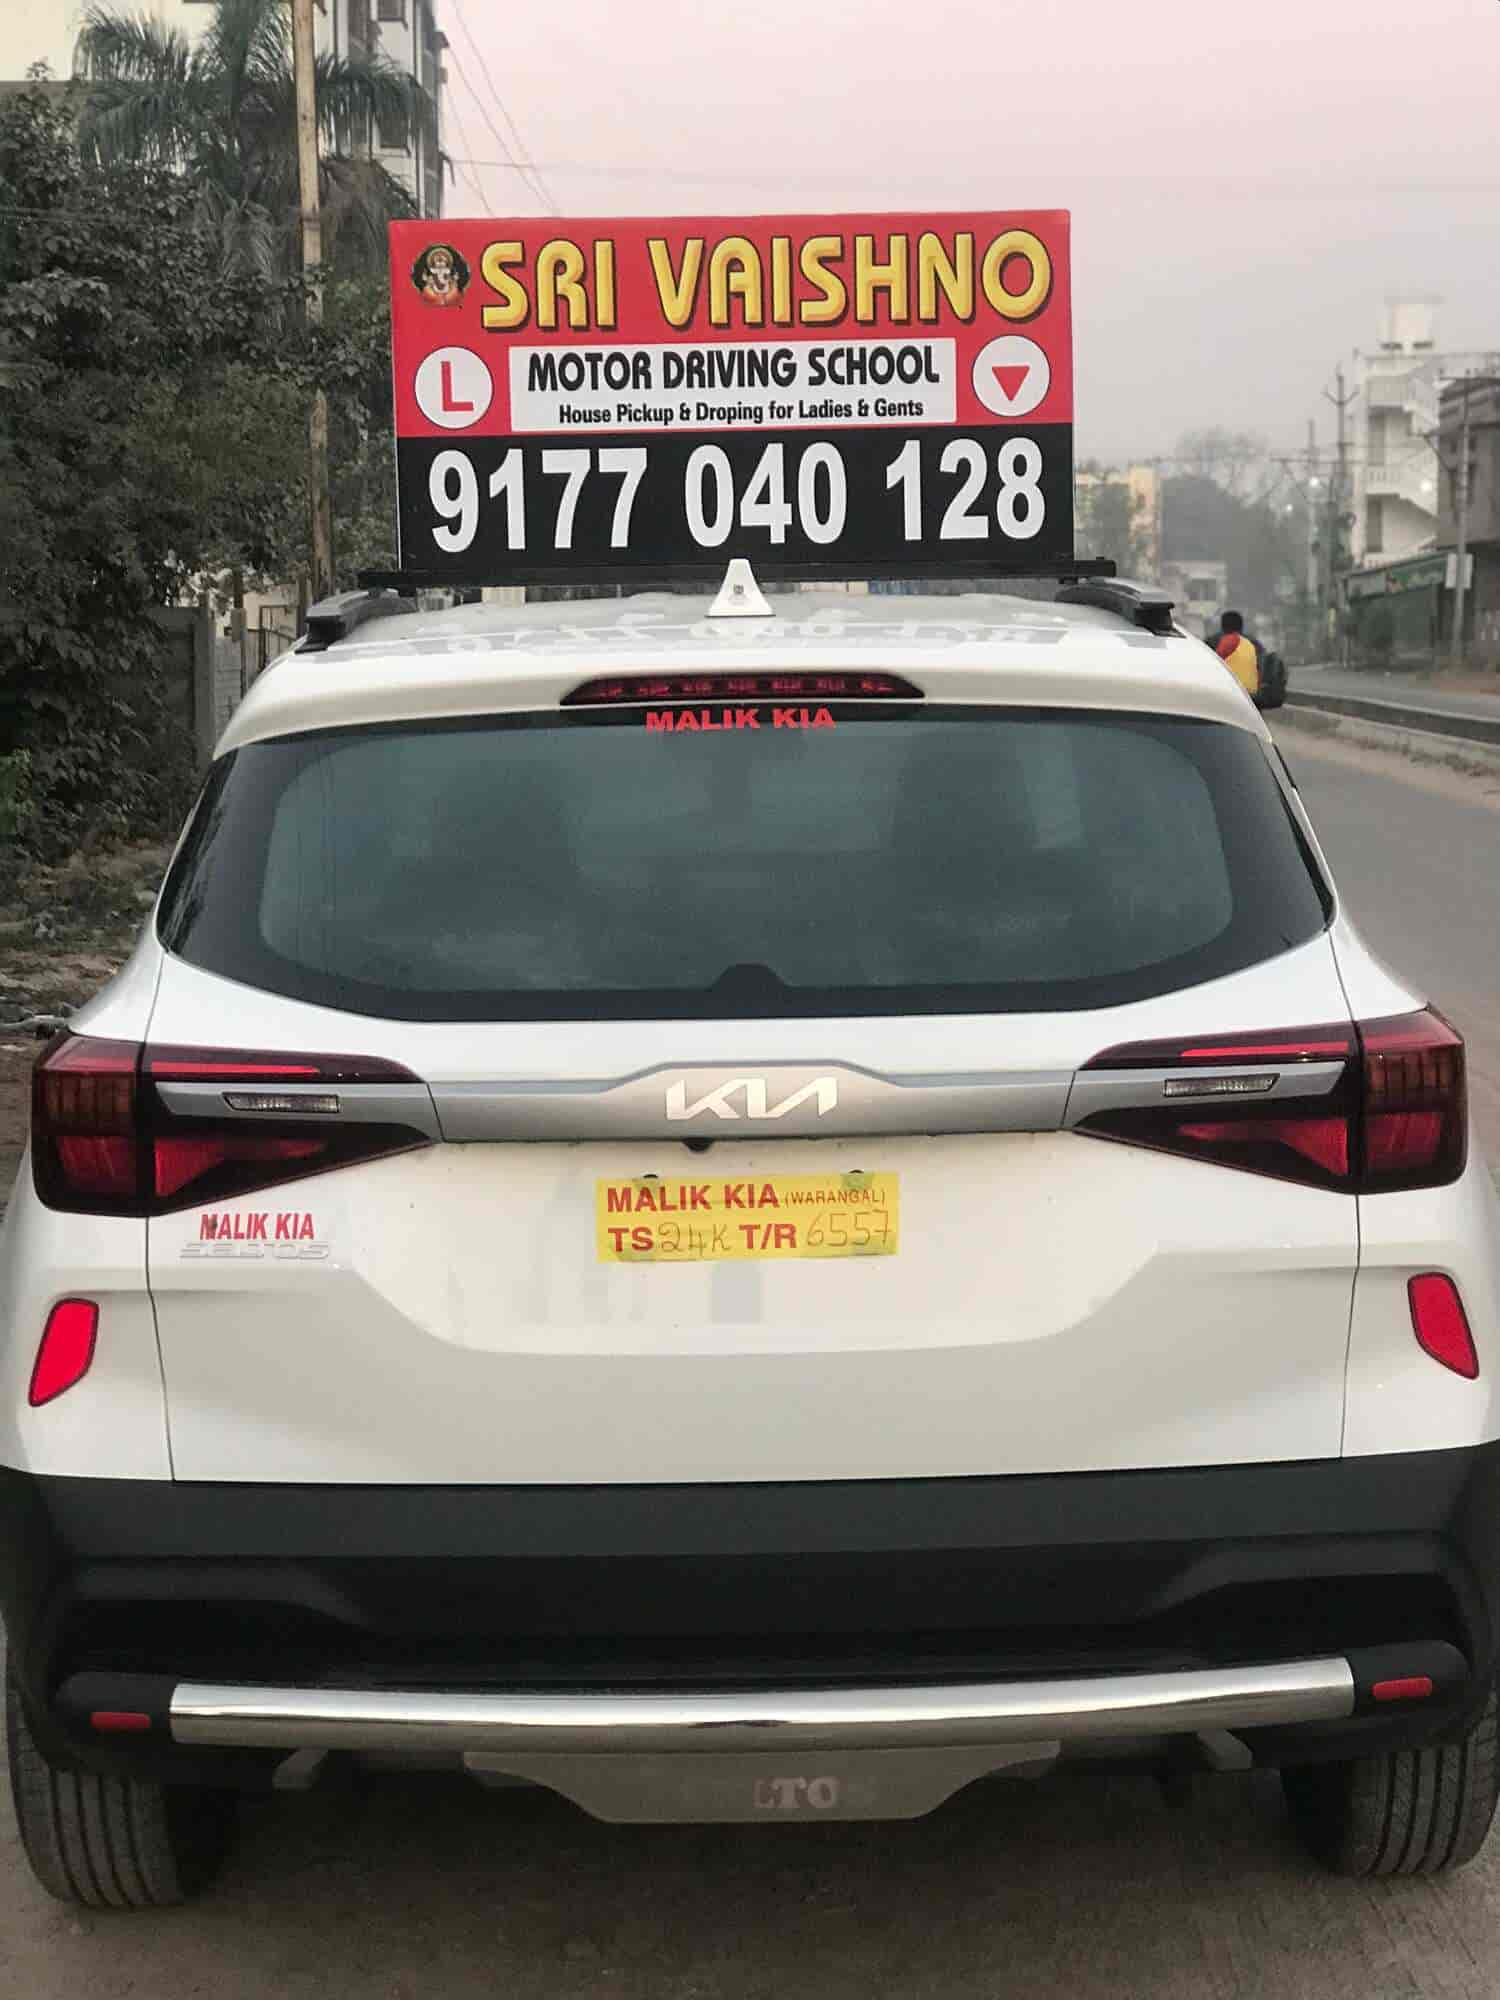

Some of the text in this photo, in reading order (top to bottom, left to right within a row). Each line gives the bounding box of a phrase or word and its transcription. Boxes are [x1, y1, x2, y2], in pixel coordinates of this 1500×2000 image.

[481, 229, 1053, 332] SRI VAISHNO
[440, 359, 473, 412] L
[528, 345, 940, 391] MOTOR DRIVING SCHOOL
[559, 398, 923, 425] House Pickup & Droping for Ladies & Gents
[428, 437, 1046, 553] 9177 040 128
[645, 707, 836, 731] MALIK KIA
[666, 1076, 838, 1120] KIA
[607, 1183, 886, 1212] MALIK KIA (WARANGAL)
[200, 1213, 315, 1240] MALIK KIA
[739, 1222, 797, 1249] T/R
[806, 1209, 893, 1247] 6557
